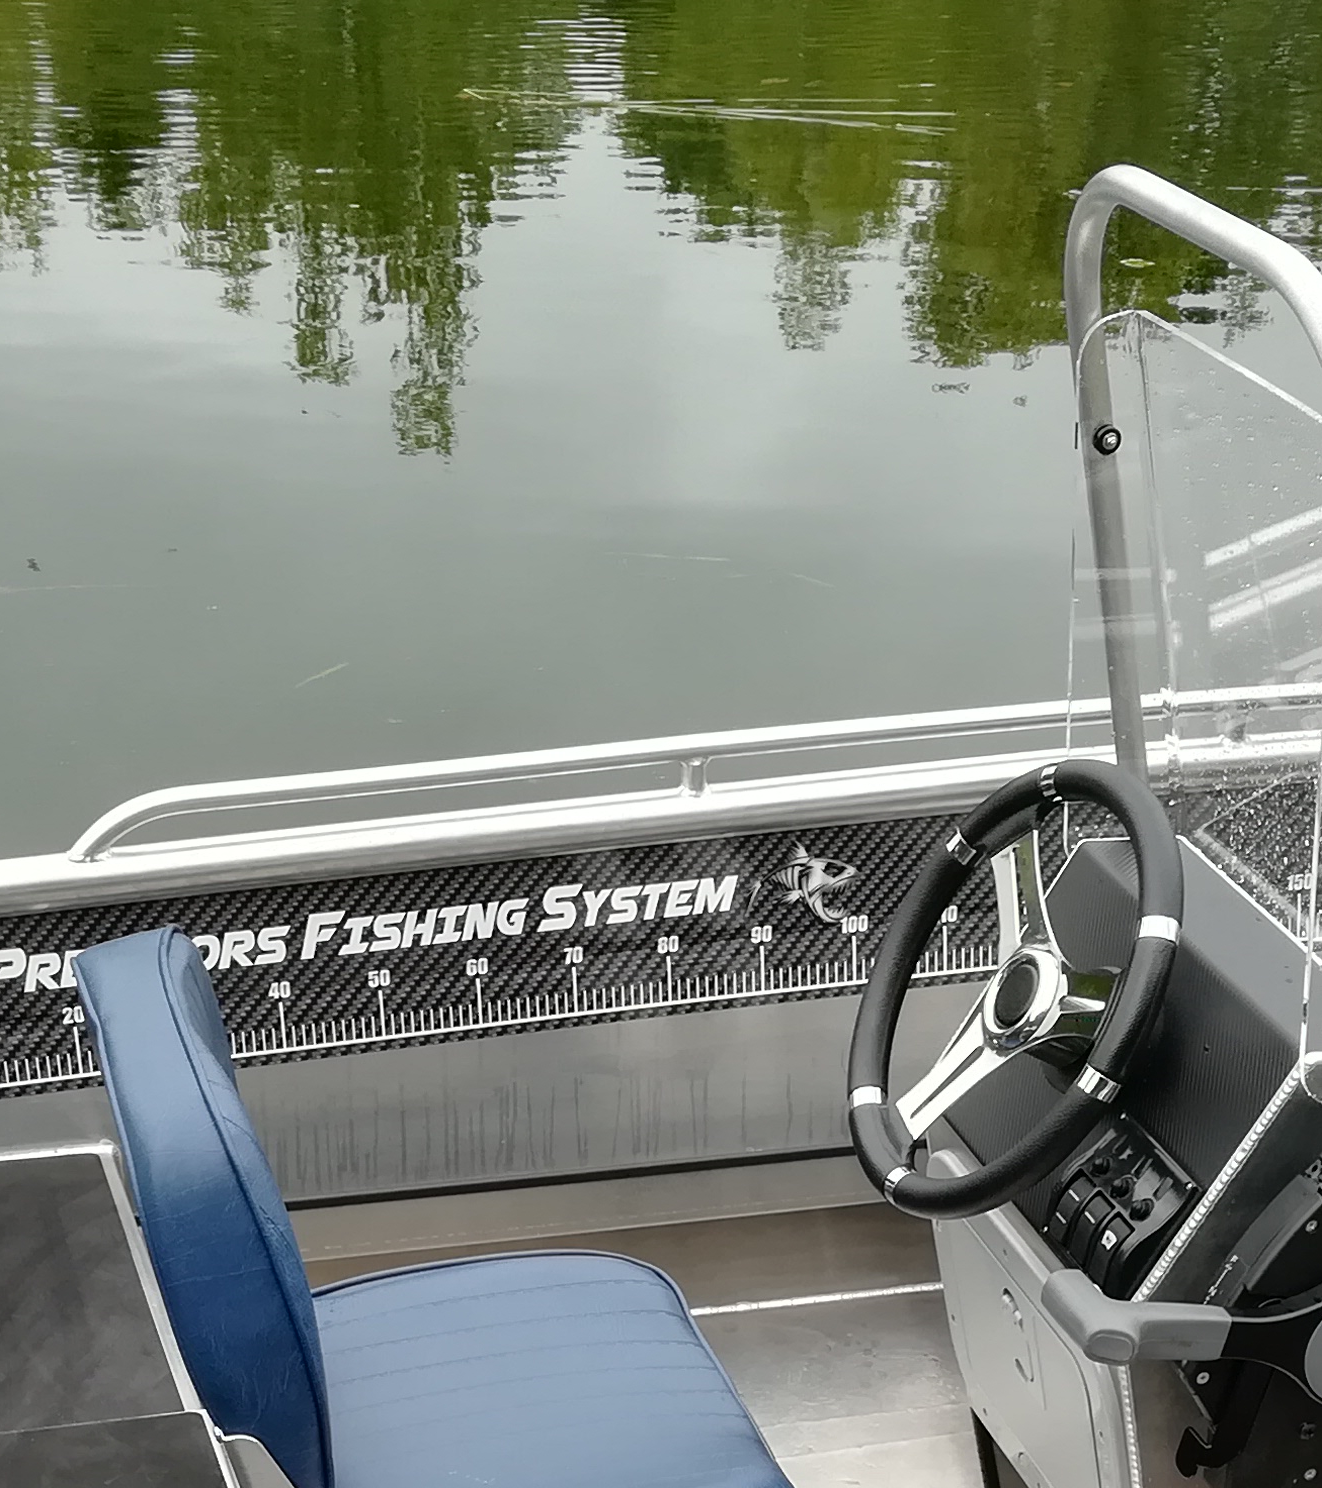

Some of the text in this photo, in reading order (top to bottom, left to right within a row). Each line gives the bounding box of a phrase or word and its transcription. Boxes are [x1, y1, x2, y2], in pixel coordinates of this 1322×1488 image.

[62, 1006, 85, 1024] 20
[269, 981, 290, 999] 40
[368, 970, 390, 988] 50
[466, 958, 488, 976] 60
[564, 946, 583, 965] 70
[658, 936, 678, 954] 80
[751, 925, 772, 944] 90
[841, 914, 869, 934] 100
[1286, 873, 1314, 891] 150
[301, 898, 530, 960] FISHING
[537, 875, 738, 932] SYSTEM
